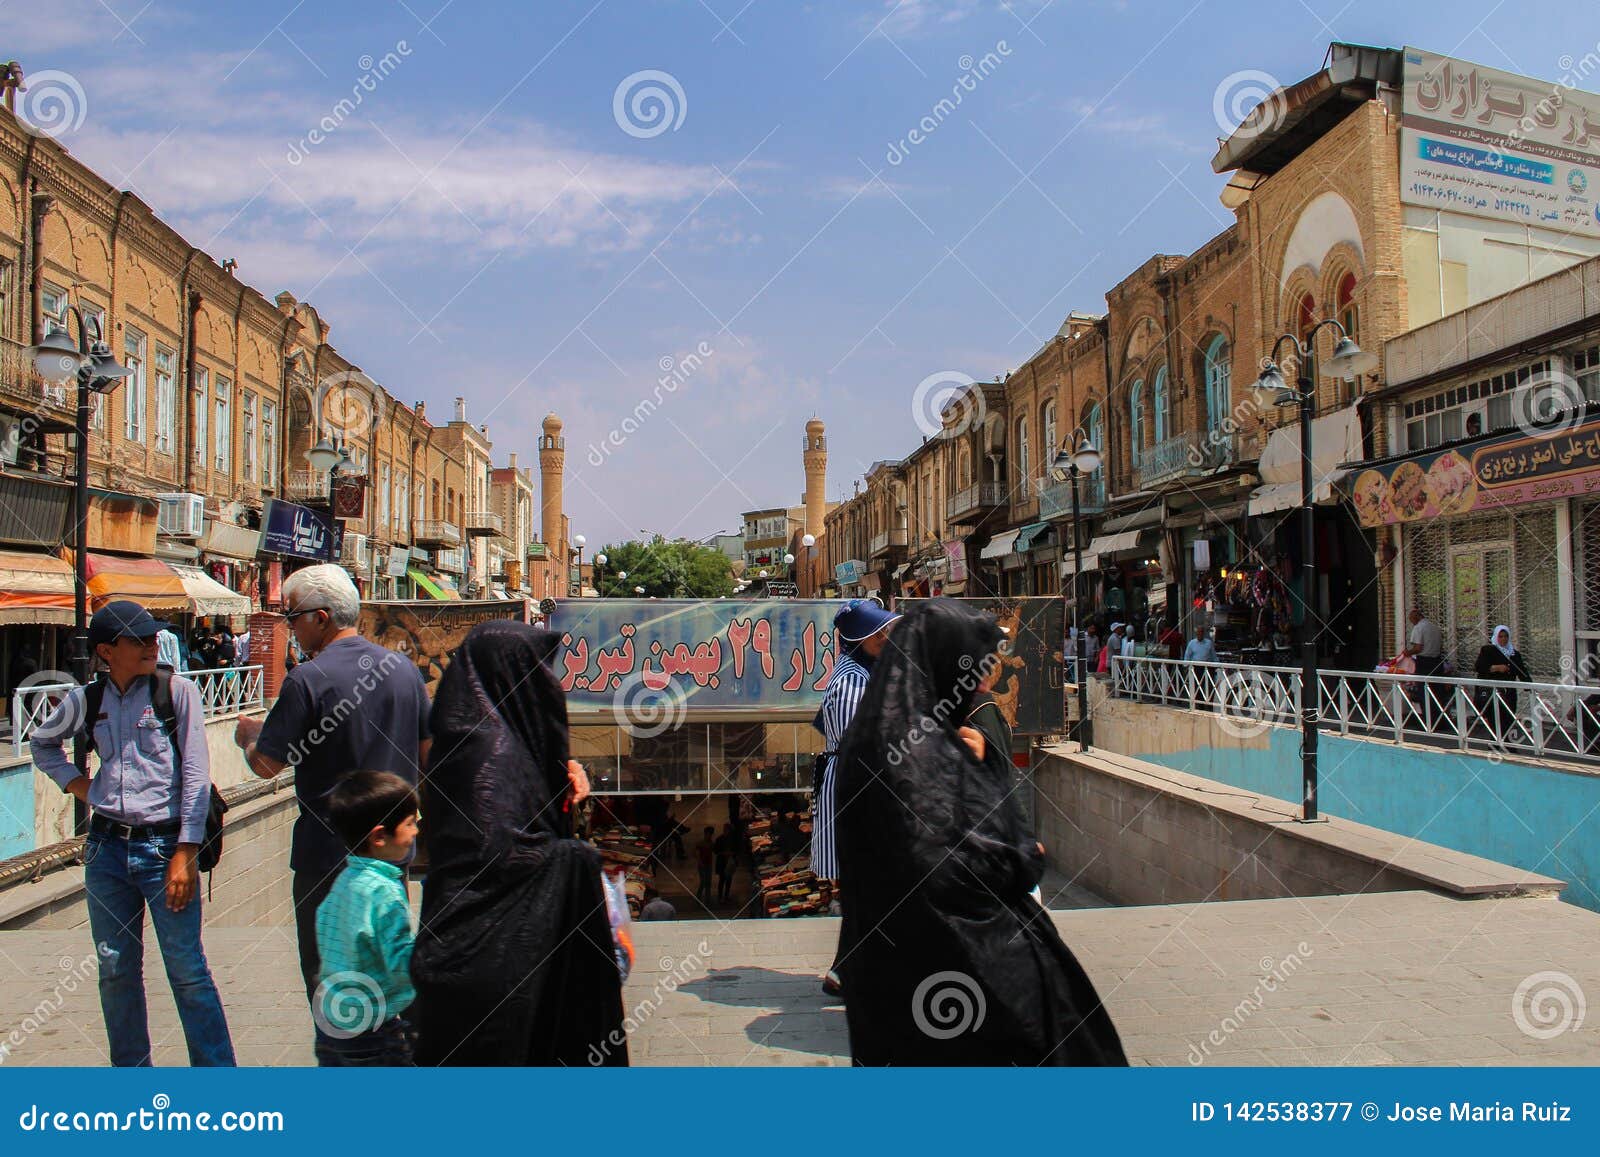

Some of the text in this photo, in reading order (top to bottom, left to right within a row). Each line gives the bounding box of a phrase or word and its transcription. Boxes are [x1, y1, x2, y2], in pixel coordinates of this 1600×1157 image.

[1416, 62, 1526, 126] بزازان
[1531, 441, 1557, 472] اصغر
[1559, 437, 1584, 465] علی
[1585, 431, 1600, 460] اج
[561, 623, 637, 692] تبریز
[642, 636, 722, 691] بهمن
[727, 618, 775, 679] ۲۹
